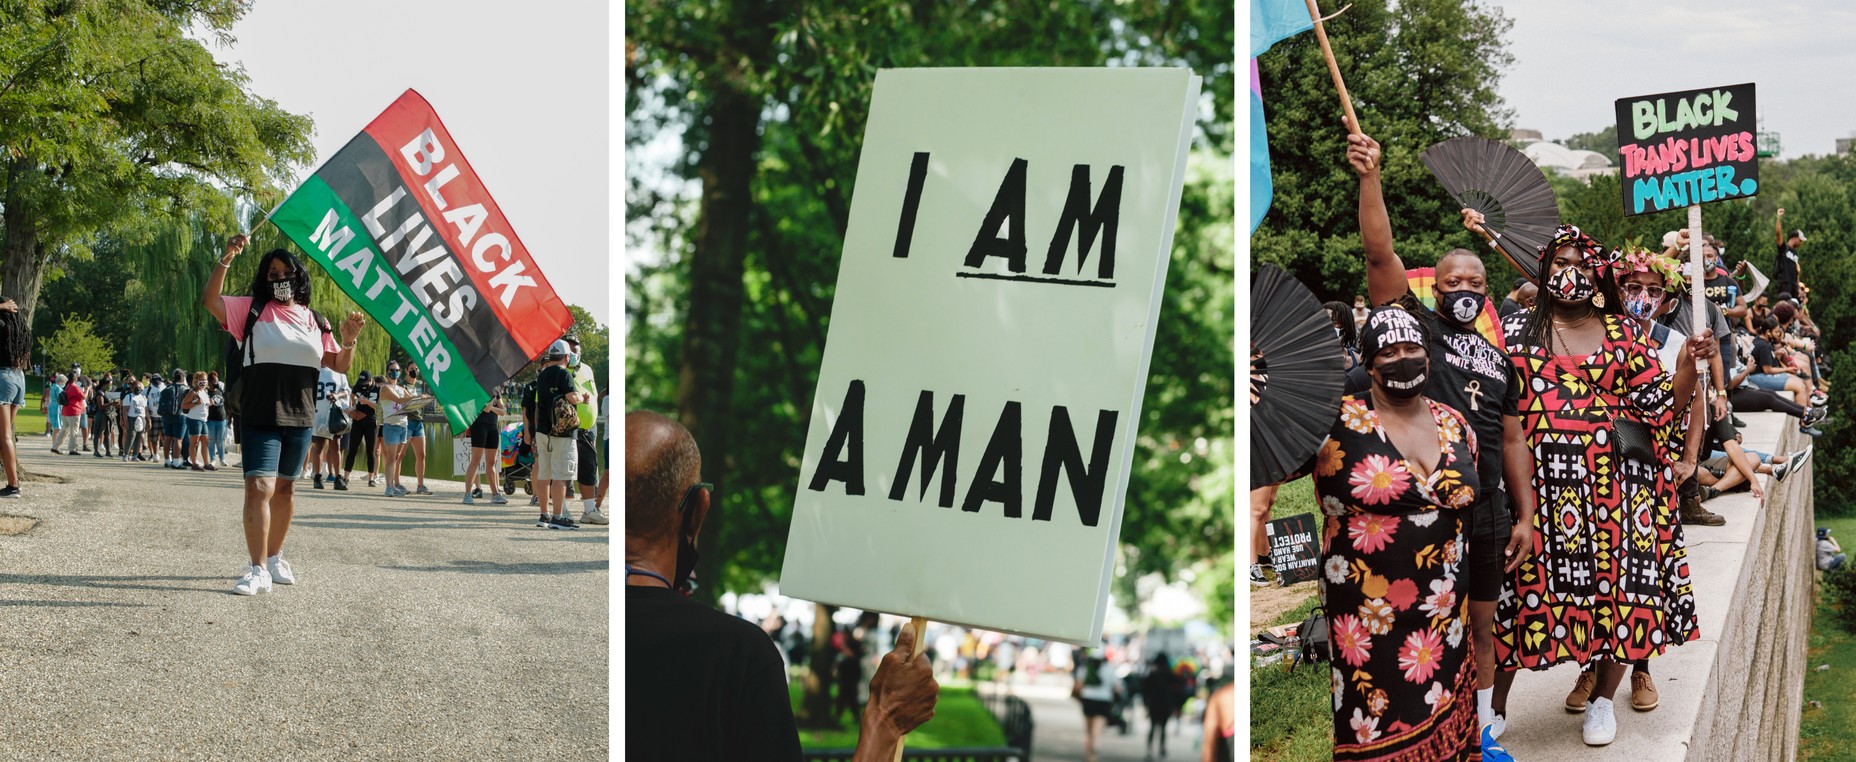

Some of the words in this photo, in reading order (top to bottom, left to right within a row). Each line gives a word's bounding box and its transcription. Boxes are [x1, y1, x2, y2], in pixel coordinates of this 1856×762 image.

[1632, 89, 1739, 140] BLACK
[1620, 137, 1689, 178] TRANS
[1690, 131, 1755, 168] LIVES
[1633, 165, 1757, 214] MATTER.
[400, 127, 538, 309] BLACK
[892, 151, 931, 259] I
[963, 157, 1125, 279] AM
[361, 185, 478, 328] LIVES
[273, 281, 291, 289] BLACK
[1705, 286, 1727, 297] OPE
[308, 208, 452, 387] MATTER
[1384, 318, 1413, 330] THE
[1377, 328, 1423, 348] POLICE
[1445, 353, 1469, 370] WHITE
[808, 379, 865, 496] A
[888, 389, 1119, 527] MAN
[1274, 531, 1312, 548] PROTECT
[1292, 544, 1304, 553] USE
[1277, 554, 1297, 563] WEAR
[1287, 558, 1317, 570] MAINTAIN
